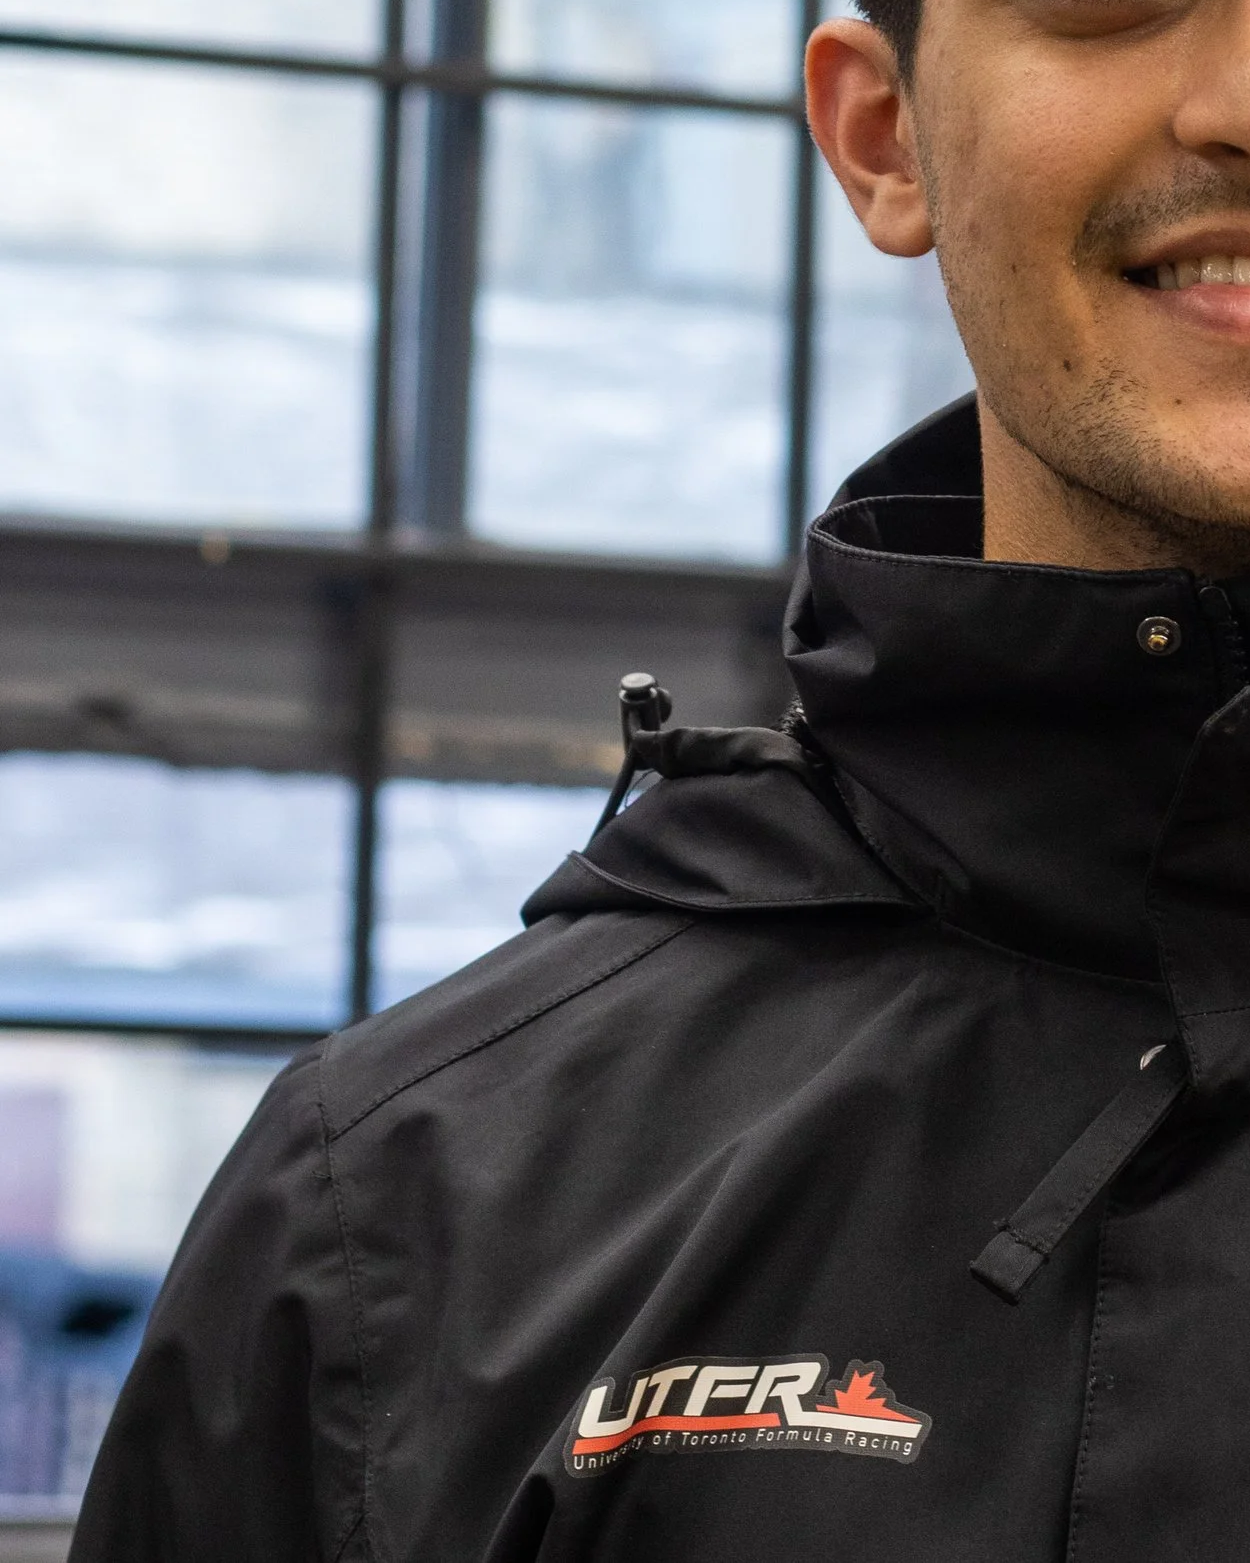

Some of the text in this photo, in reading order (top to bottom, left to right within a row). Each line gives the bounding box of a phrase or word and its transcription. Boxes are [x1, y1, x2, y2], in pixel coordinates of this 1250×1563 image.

[578, 1362, 822, 1439] UTFR
[573, 1428, 914, 1470] University of Toronto Formula Racing
